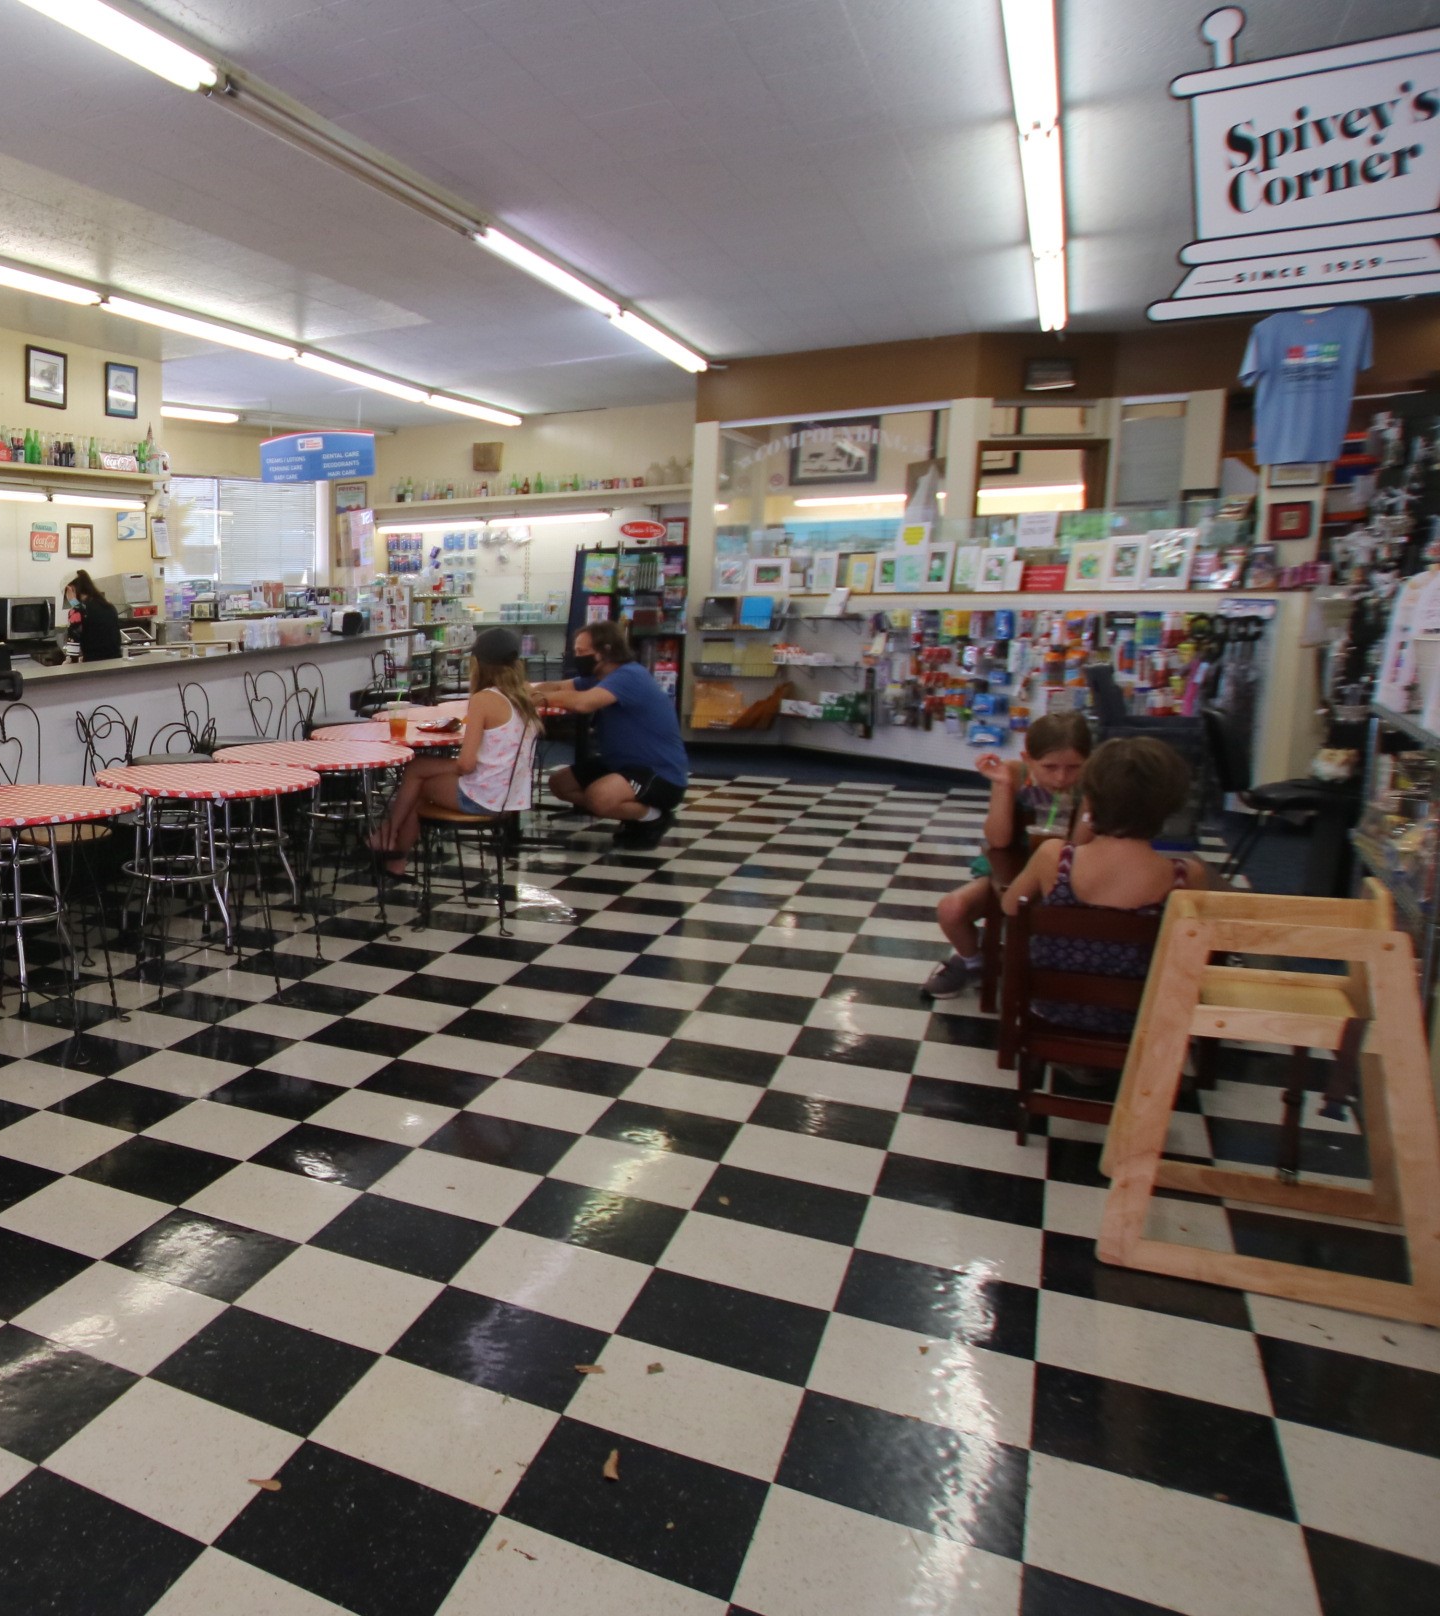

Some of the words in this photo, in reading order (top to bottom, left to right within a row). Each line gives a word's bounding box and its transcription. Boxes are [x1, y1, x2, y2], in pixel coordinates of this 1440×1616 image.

[1227, 81, 1440, 175] Spivey's
[1229, 144, 1423, 214] Corner
[1235, 266, 1307, 284] SINCE
[1323, 257, 1384, 278] 1959
[265, 457, 283, 465] CREAMS
[286, 455, 306, 463] LOTIONS
[322, 453, 343, 462] DENTAL
[344, 450, 360, 460] CARE
[290, 464, 303, 472] CARE
[323, 459, 360, 469] DEODORANTS
[285, 473, 298, 481] CARE
[327, 470, 341, 479] HAIR
[341, 468, 357, 478] CARE
